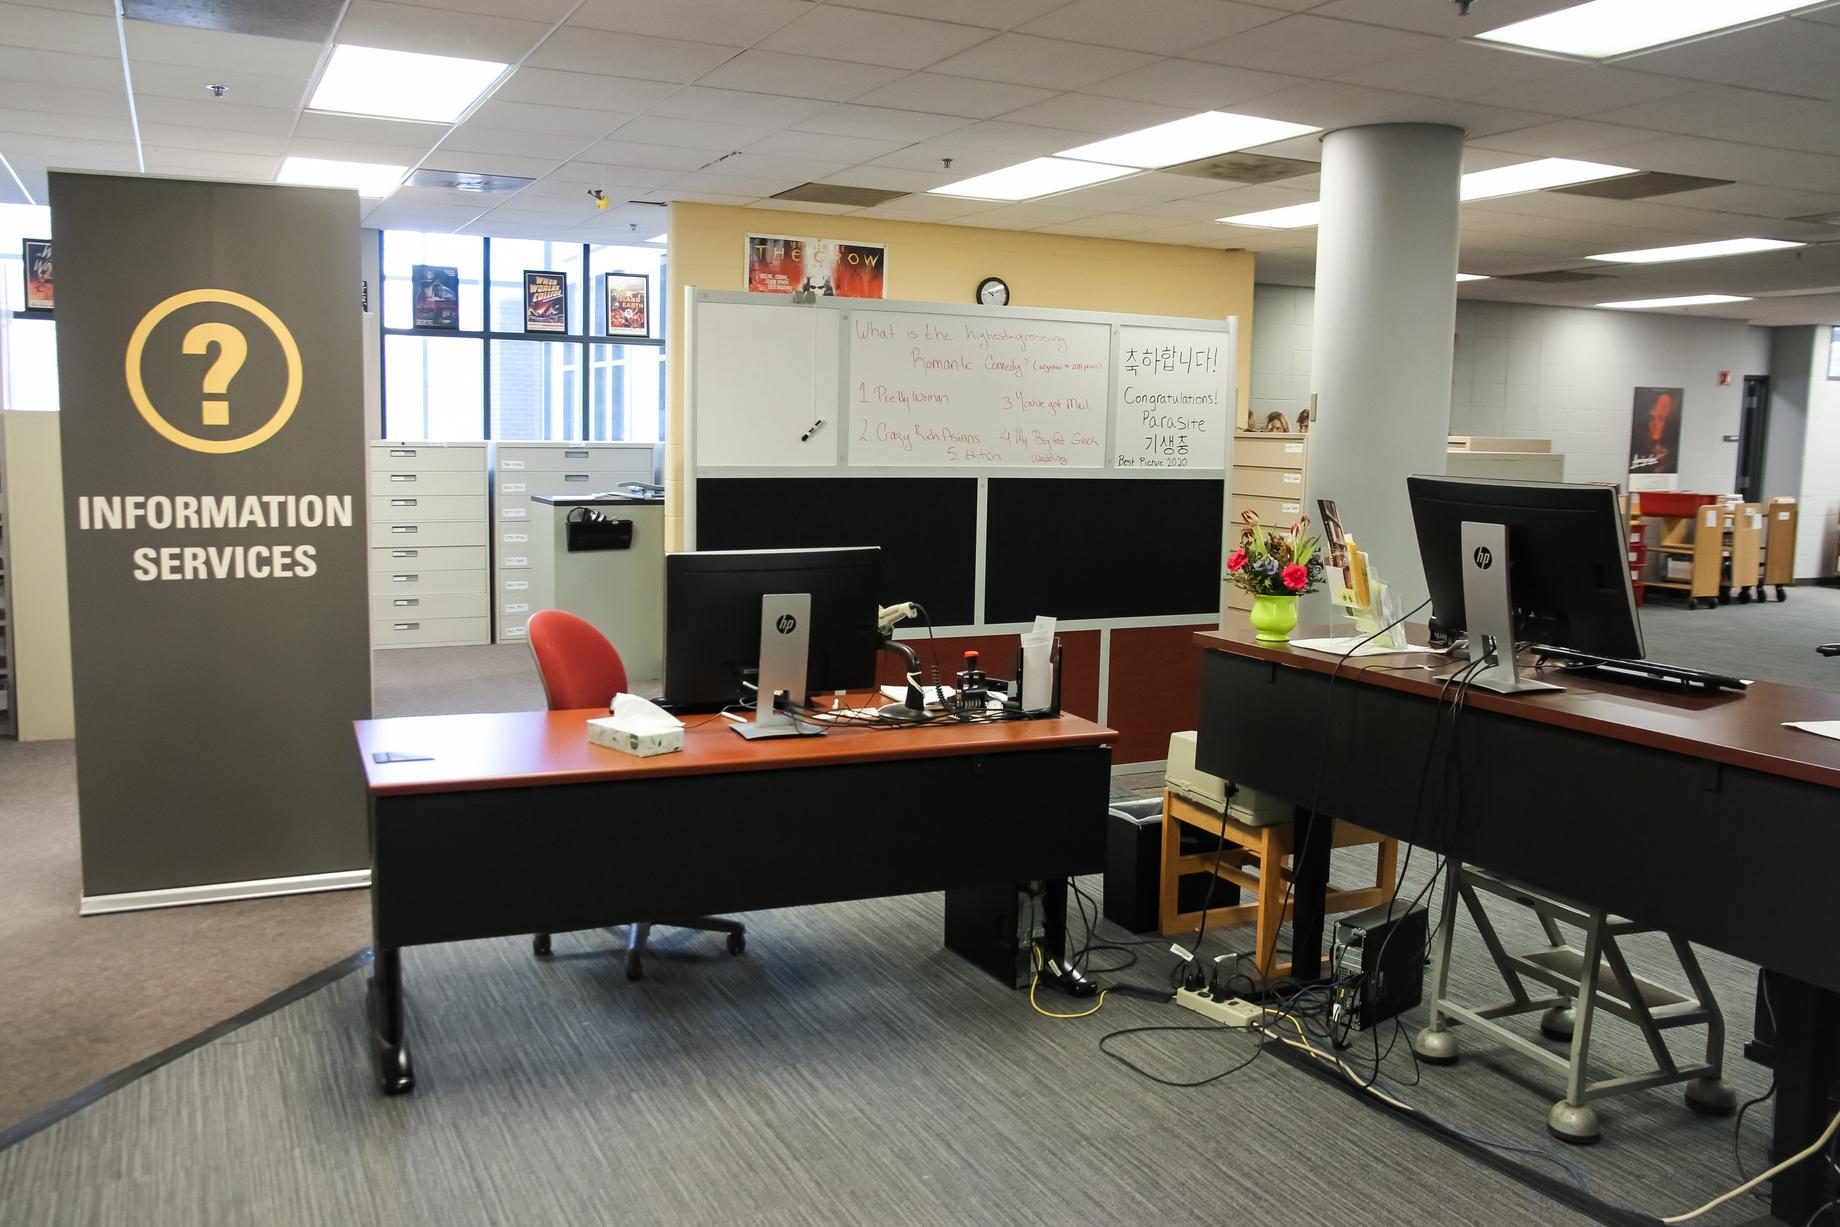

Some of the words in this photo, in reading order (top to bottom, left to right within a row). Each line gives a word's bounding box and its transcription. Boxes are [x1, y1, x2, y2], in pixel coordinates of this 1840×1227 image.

[754, 244, 802, 262] THE
[814, 248, 879, 268] CROW
[856, 319, 894, 340] What
[907, 329, 918, 339] is
[924, 318, 953, 341] the
[1124, 386, 1218, 411] Congratulations!
[876, 422, 913, 452] Crazy
[1118, 454, 1135, 467] Best
[1166, 457, 1188, 467] 2020
[78, 494, 353, 530] INFORMATION
[133, 545, 318, 581] SERVICES
[1474, 545, 1492, 570] hp
[776, 614, 796, 635] hp
